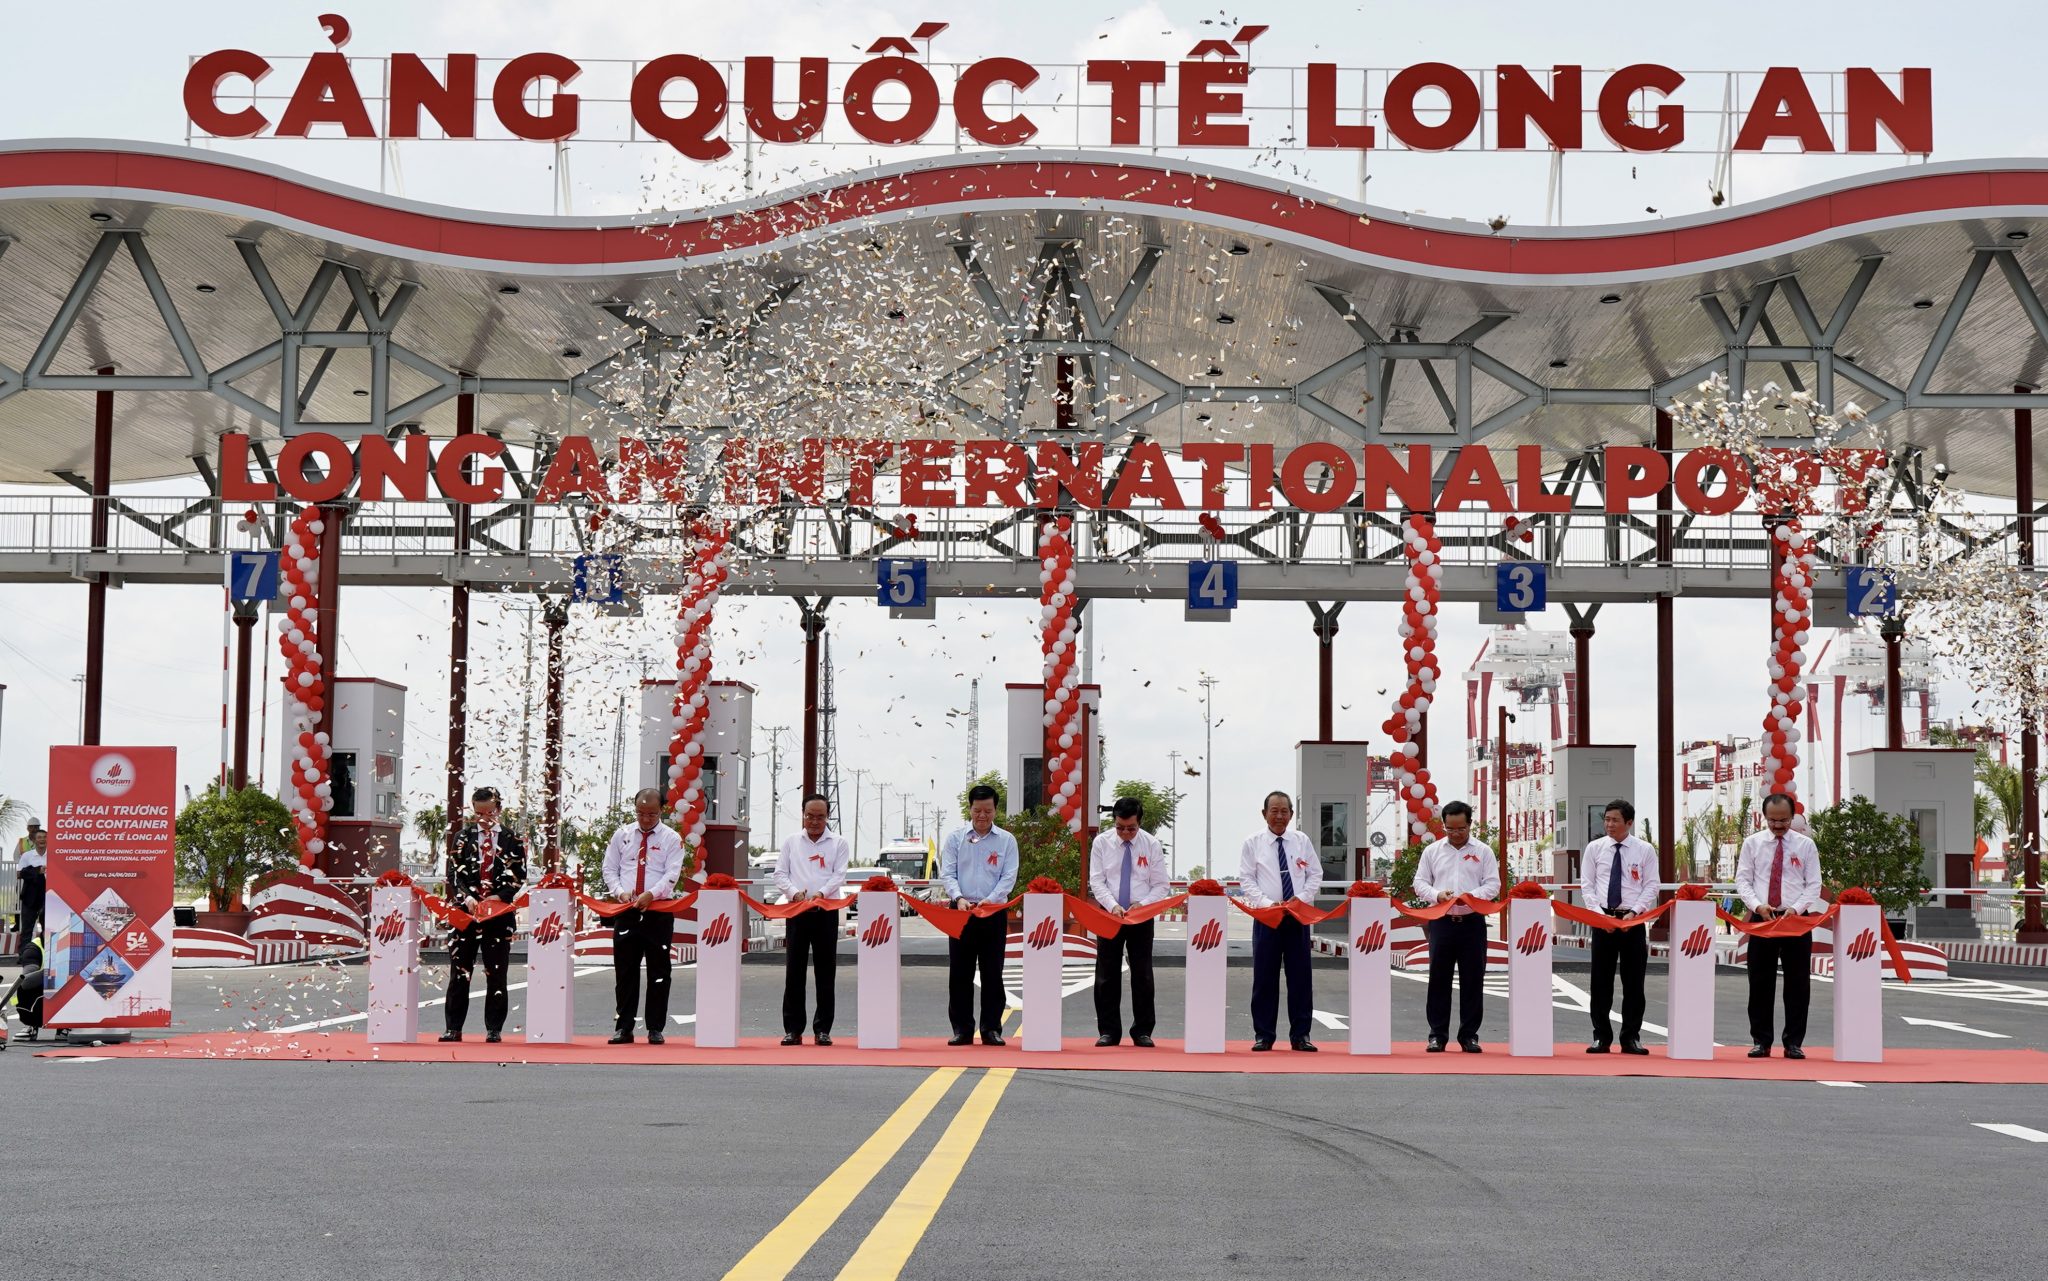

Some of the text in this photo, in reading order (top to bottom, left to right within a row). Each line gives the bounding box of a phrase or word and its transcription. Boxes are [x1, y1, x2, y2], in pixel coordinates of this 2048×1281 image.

[183, 14, 1932, 160] CẢNG QUỐC TẾ LONG AN
[220, 432, 1887, 516] LONG AN INTERNATIONAL PORT
[240, 555, 268, 597] 7
[889, 561, 914, 603] 5
[1199, 564, 1228, 606] 4
[1509, 566, 1534, 608] 3
[1857, 570, 1888, 615] 2
[95, 777, 131, 785] Dongtam
[56, 801, 169, 816] LỄ KHAI TRƯƠNG
[56, 817, 169, 829] CỔNG CONTAINER
[56, 831, 82, 841] CẢNG
[84, 831, 111, 841] QUỐC
[114, 831, 126, 841] TẾ
[126, 932, 148, 950] 54
